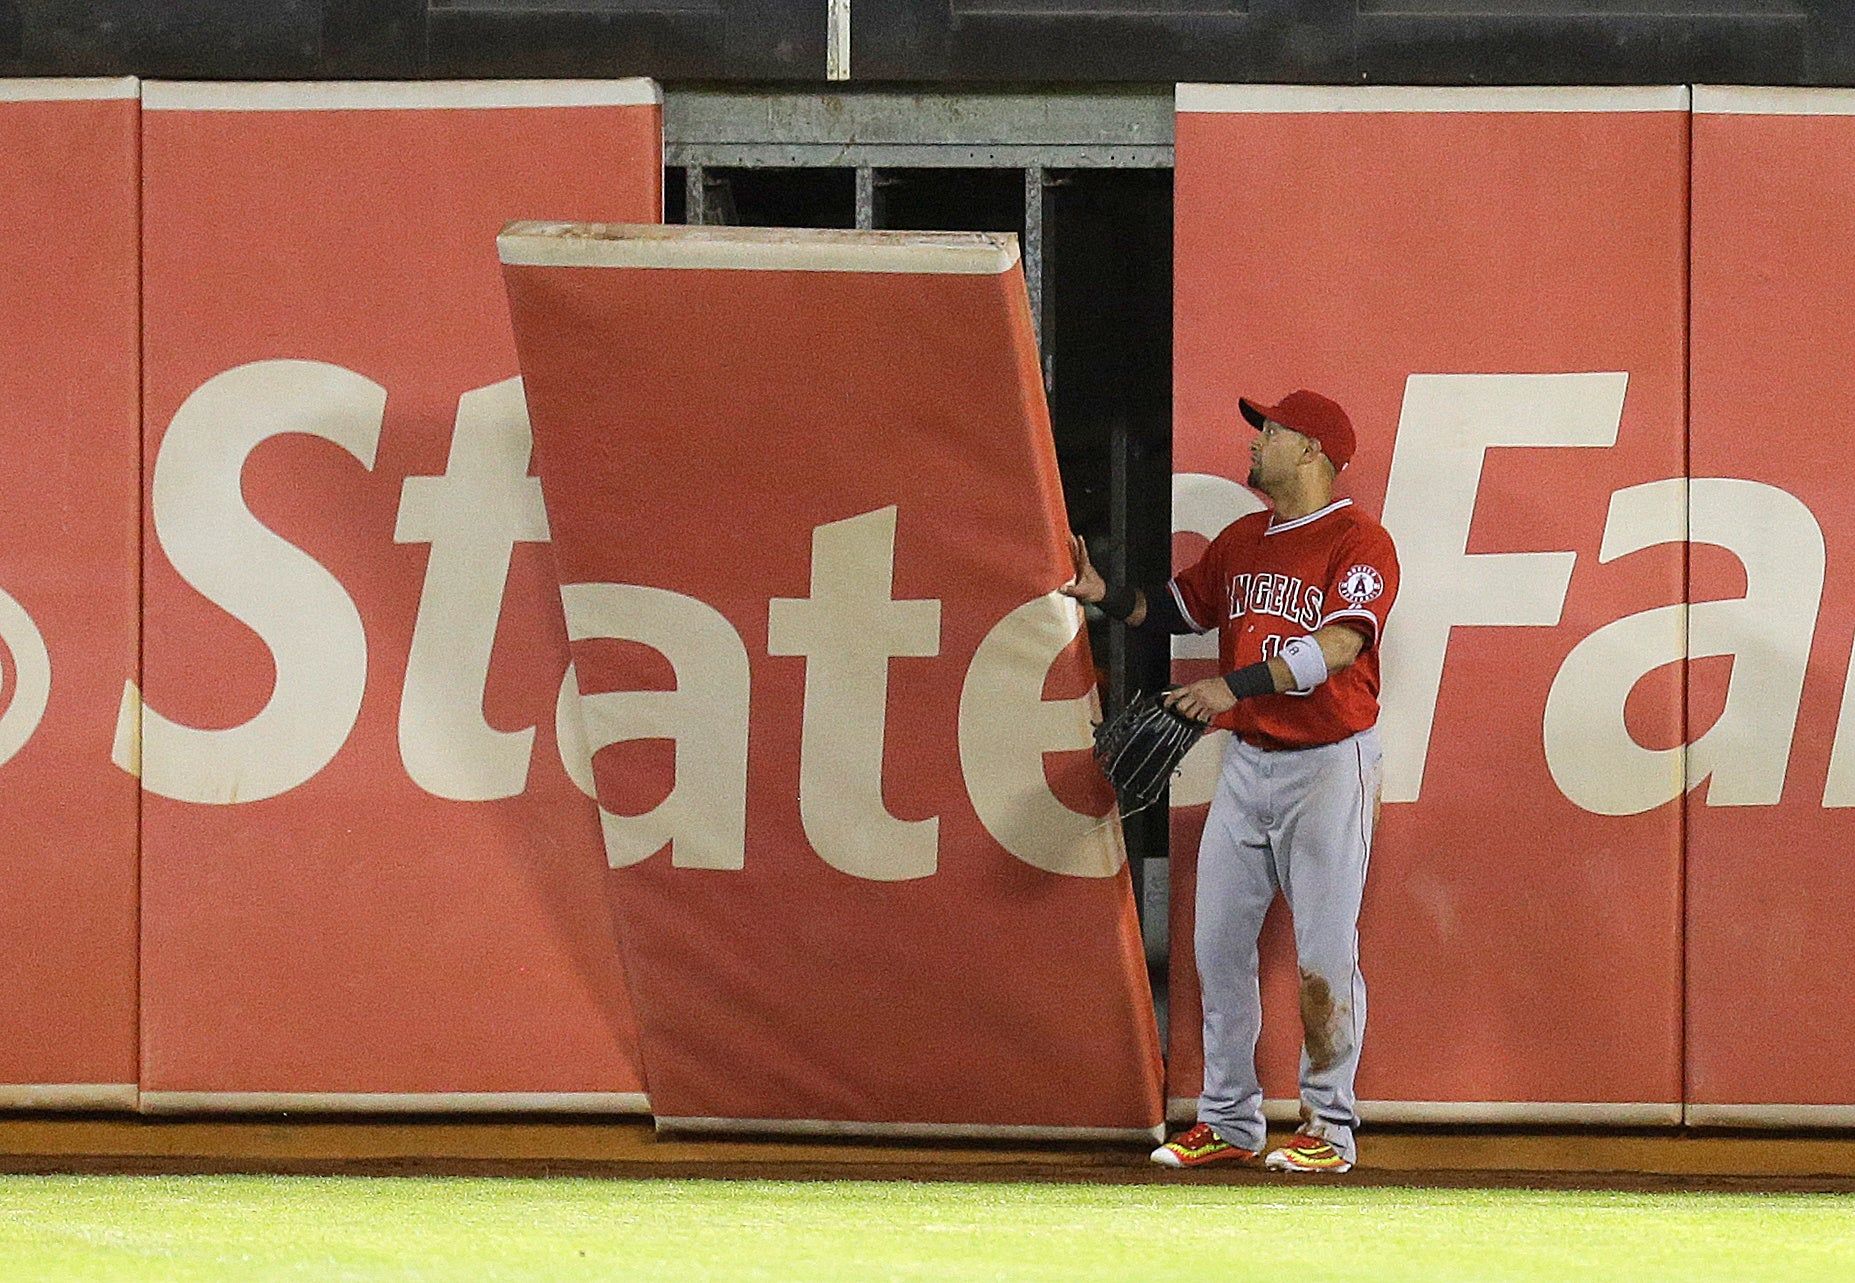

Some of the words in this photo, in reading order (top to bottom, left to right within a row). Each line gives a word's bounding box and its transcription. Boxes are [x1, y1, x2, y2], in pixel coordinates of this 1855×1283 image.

[112, 358, 1125, 882] State
[1380, 371, 1855, 816] Fa
[1227, 572, 1324, 632] NGELS
